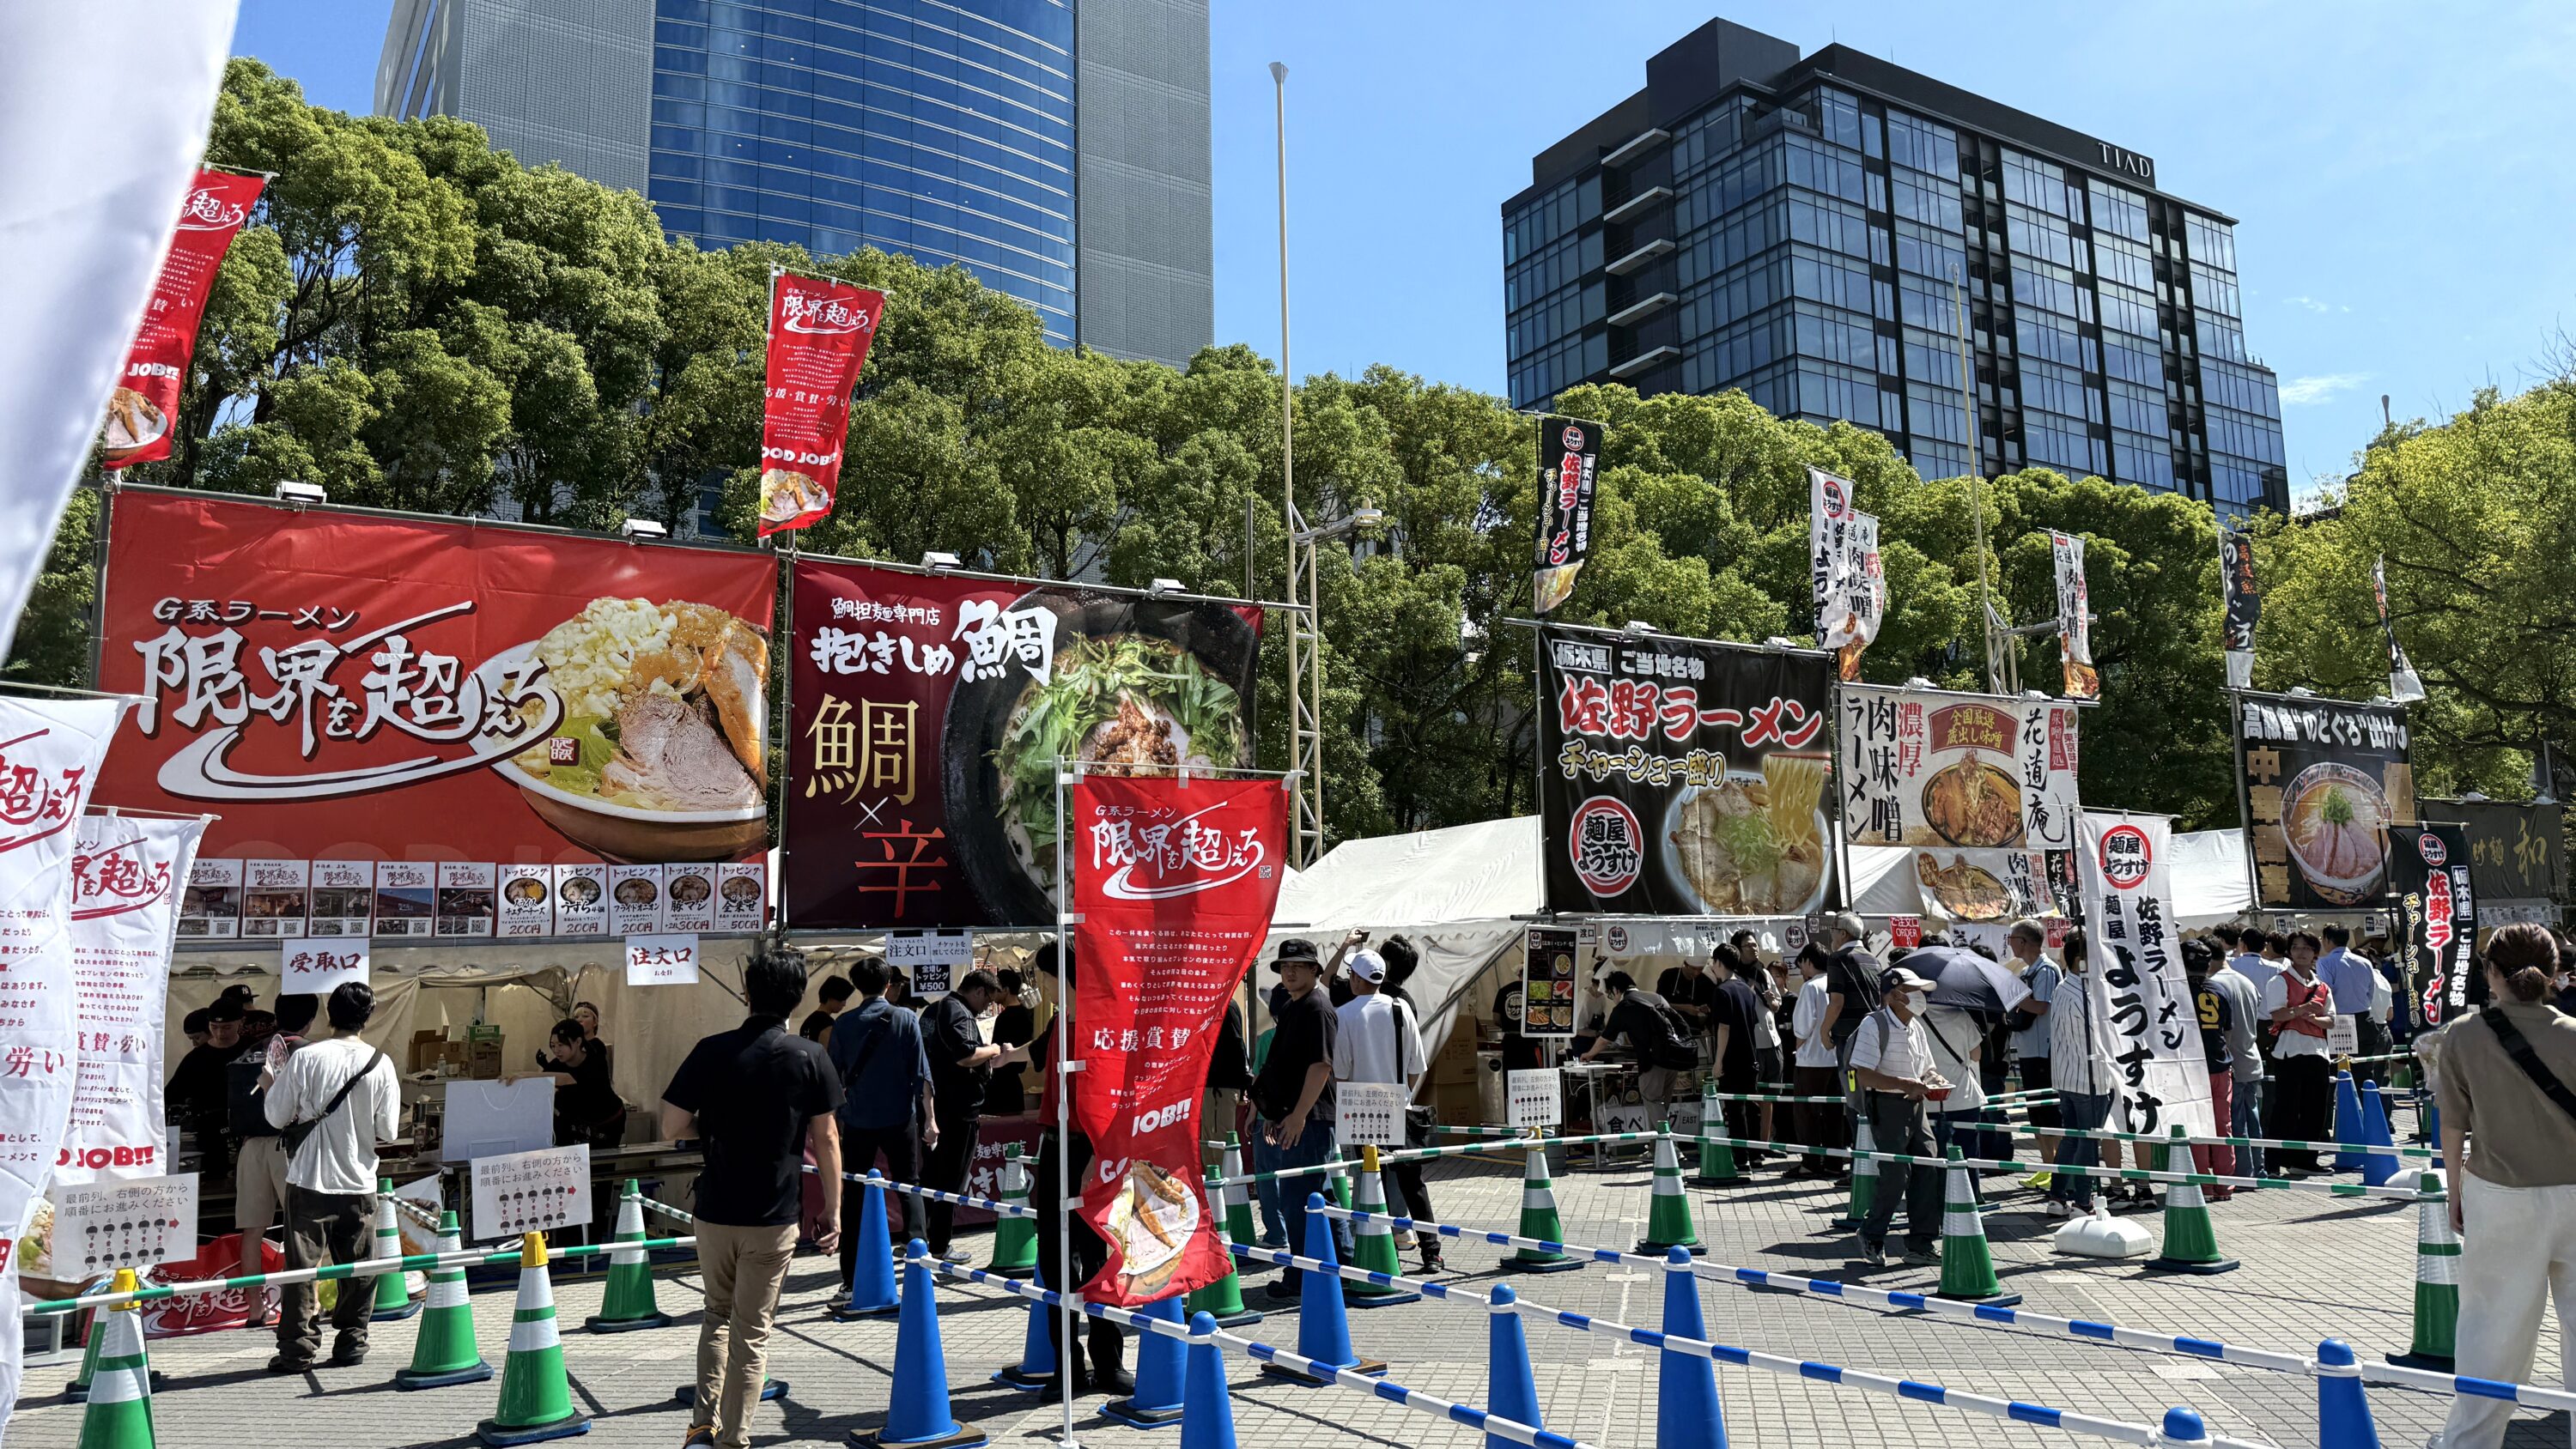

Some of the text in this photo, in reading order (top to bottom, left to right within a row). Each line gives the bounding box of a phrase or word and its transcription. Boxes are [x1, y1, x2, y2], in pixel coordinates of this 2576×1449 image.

[2098, 142, 2150, 177] TIAD
[782, 296, 869, 329] 限界を超えろ
[762, 446, 795, 462] OOD
[1550, 452, 1581, 565] 佐野ラーメン
[152, 597, 357, 630] G系ラーメン
[831, 597, 940, 626] 鯛担麺専門店
[1556, 644, 1705, 680] 栃木県 ご当地名物
[134, 601, 563, 764] 限界を超えろ
[1558, 673, 1822, 749] 佐野ラーメン
[1950, 708, 1995, 730] 全国厳選
[1898, 701, 1924, 778] 濃厚
[1947, 728, 2002, 749] 蔵出し味噌
[1558, 738, 1726, 788] チャーシュー盛り
[1846, 697, 1869, 841] ラーメン
[1868, 696, 1902, 841] 肉味噌
[2023, 708, 2066, 843] 花道庵
[1096, 804, 1176, 818] G系ラーメン
[1584, 815, 1627, 843] 麺屋
[1089, 802, 1265, 881] 限界を超えろ
[2109, 835, 2141, 855] 麺屋
[505, 868, 550, 877] トッピング
[560, 867, 605, 877] トッピング
[613, 868, 659, 878] トッピング
[668, 866, 712, 876] トッピング
[722, 866, 762, 876] トッピング
[854, 818, 948, 919] 辛
[1578, 849, 1639, 874] ようすけ
[2102, 858, 2149, 876] ようすけ
[508, 925, 541, 935] 200円
[567, 923, 598, 934] 200円
[622, 922, 653, 933] 200円
[731, 920, 759, 930] 500円
[1891, 918, 1919, 927] ご注文口
[1896, 929, 1918, 937] ORDER
[2424, 870, 2453, 1026] 佐野ラーメン
[2449, 870, 2473, 1007] 栃木県 ご当地名物
[289, 951, 361, 973] 受取口
[631, 945, 693, 966] 注文口
[889, 944, 926, 958] 注文口
[915, 972, 950, 981] トッピング
[2136, 895, 2184, 1051] 佐野ラーメン
[919, 981, 945, 991] ¥500
[2105, 945, 2163, 1135] ようすけ
[5, 1046, 64, 1078] 労い
[77, 1145, 155, 1169] JOB!!
[480, 1153, 582, 1176] 最前列、右側の方から
[480, 1166, 583, 1187] 順番にお進みください
[65, 1182, 189, 1205] 最前列、右側の方から
[64, 1196, 189, 1217] 順番にお進みください
